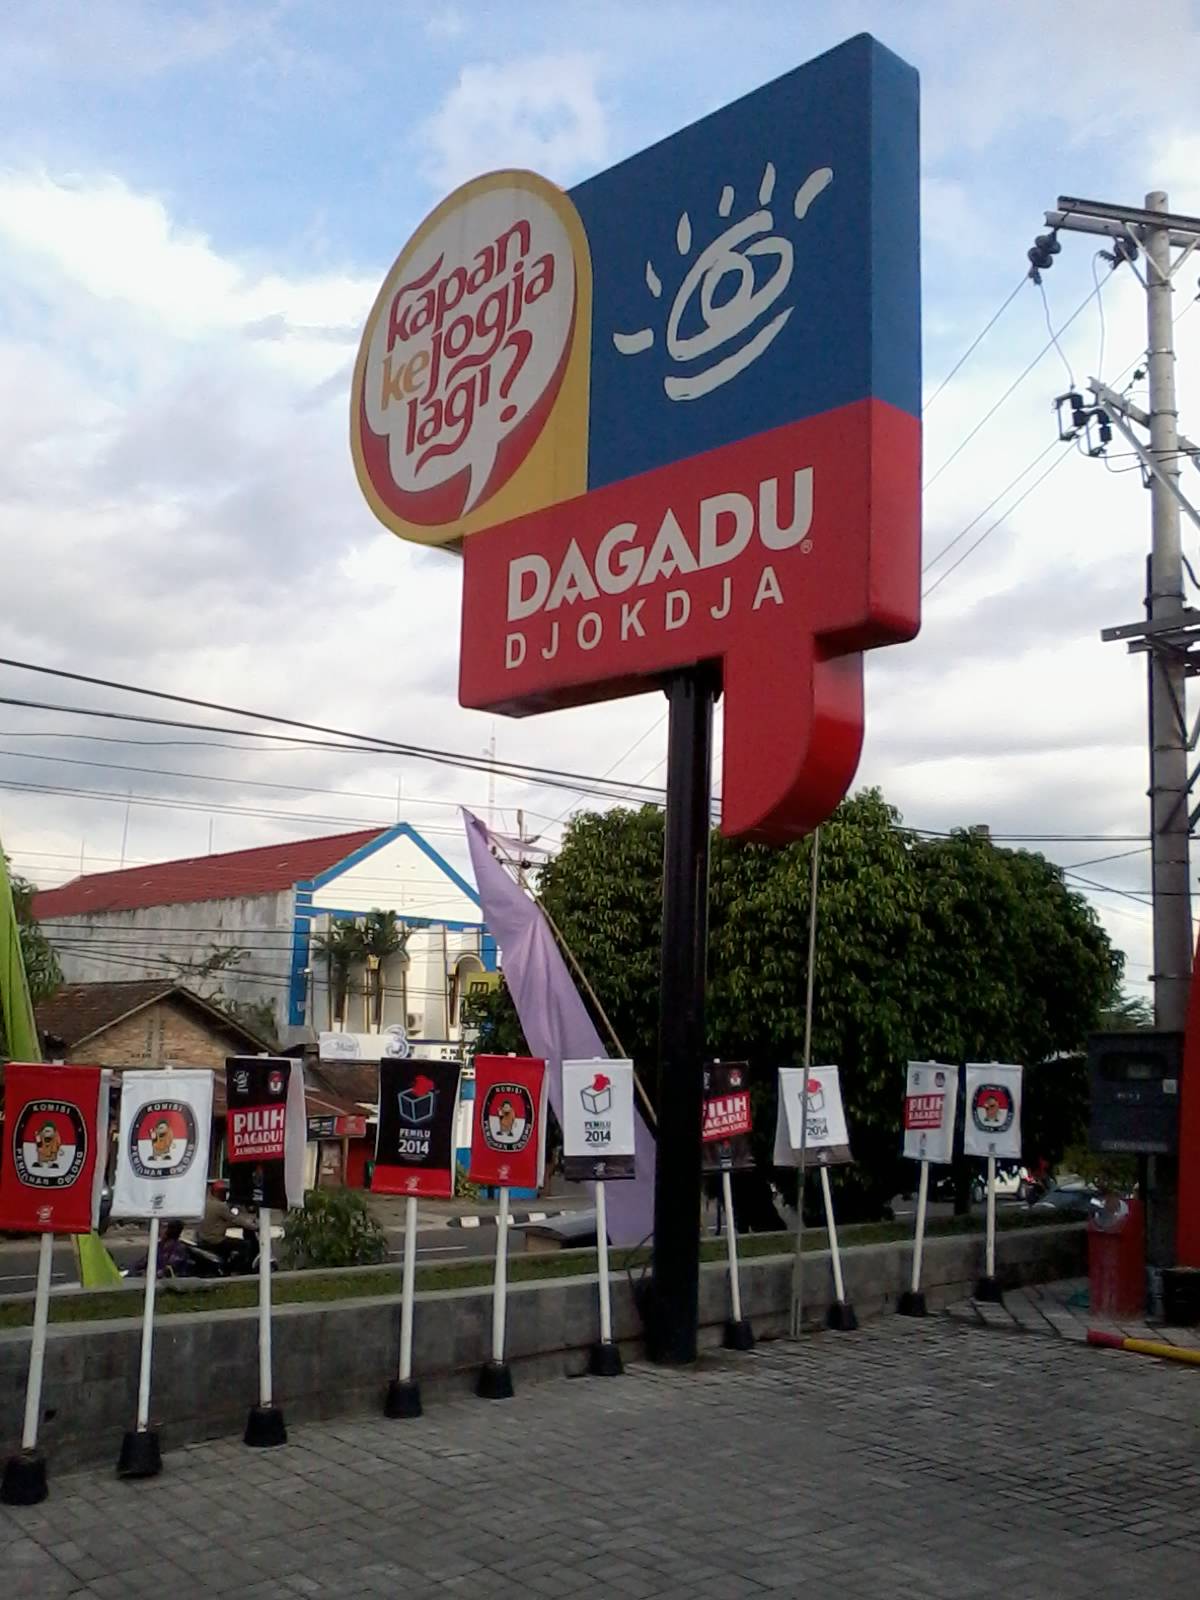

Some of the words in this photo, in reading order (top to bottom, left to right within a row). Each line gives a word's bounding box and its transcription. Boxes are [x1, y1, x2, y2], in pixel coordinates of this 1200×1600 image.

[387, 219, 531, 353] kapan
[381, 349, 430, 411] ke
[420, 253, 555, 405] jogja
[406, 329, 533, 478] lagi?
[507, 466, 814, 623] DAGADU
[505, 566, 784, 670] DJOKDJA
[233, 1107, 285, 1133] PILIH
[398, 1139, 430, 1154] 2014
[400, 1127, 431, 1138] PEMILU
[585, 1130, 612, 1142] 2014
[806, 1125, 829, 1136] 2014
